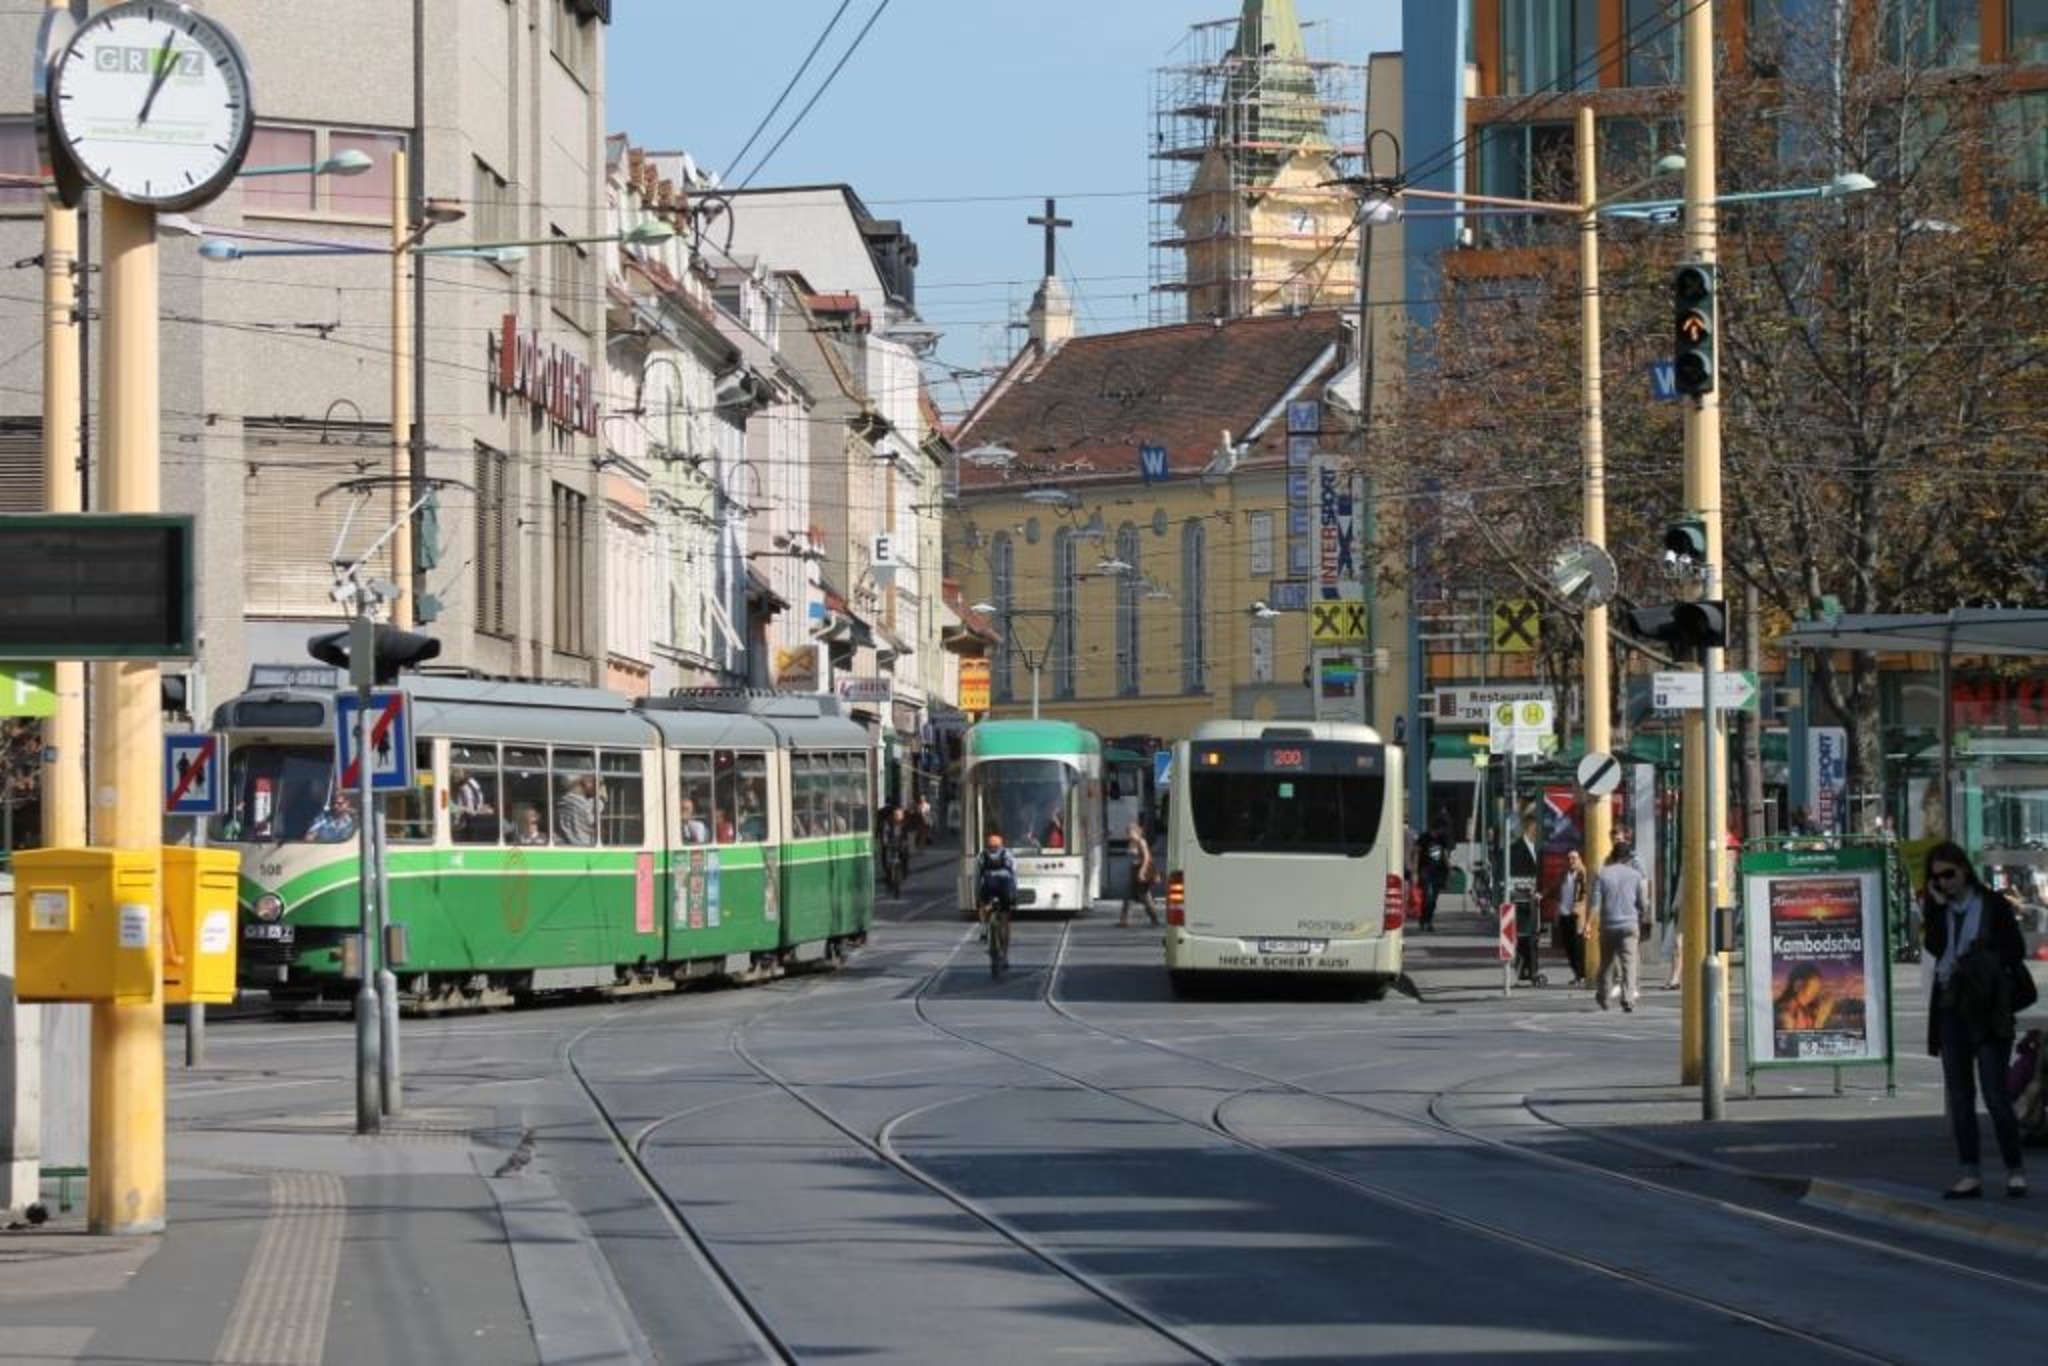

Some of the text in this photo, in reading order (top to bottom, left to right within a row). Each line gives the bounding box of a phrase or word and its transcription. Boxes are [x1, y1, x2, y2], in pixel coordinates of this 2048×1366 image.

[1142, 450, 1164, 475] W
[1320, 467, 1338, 585] INTERSPORT
[876, 538, 888, 560] E
[16, 672, 40, 706] F
[1773, 933, 1861, 954] Kambodscha
